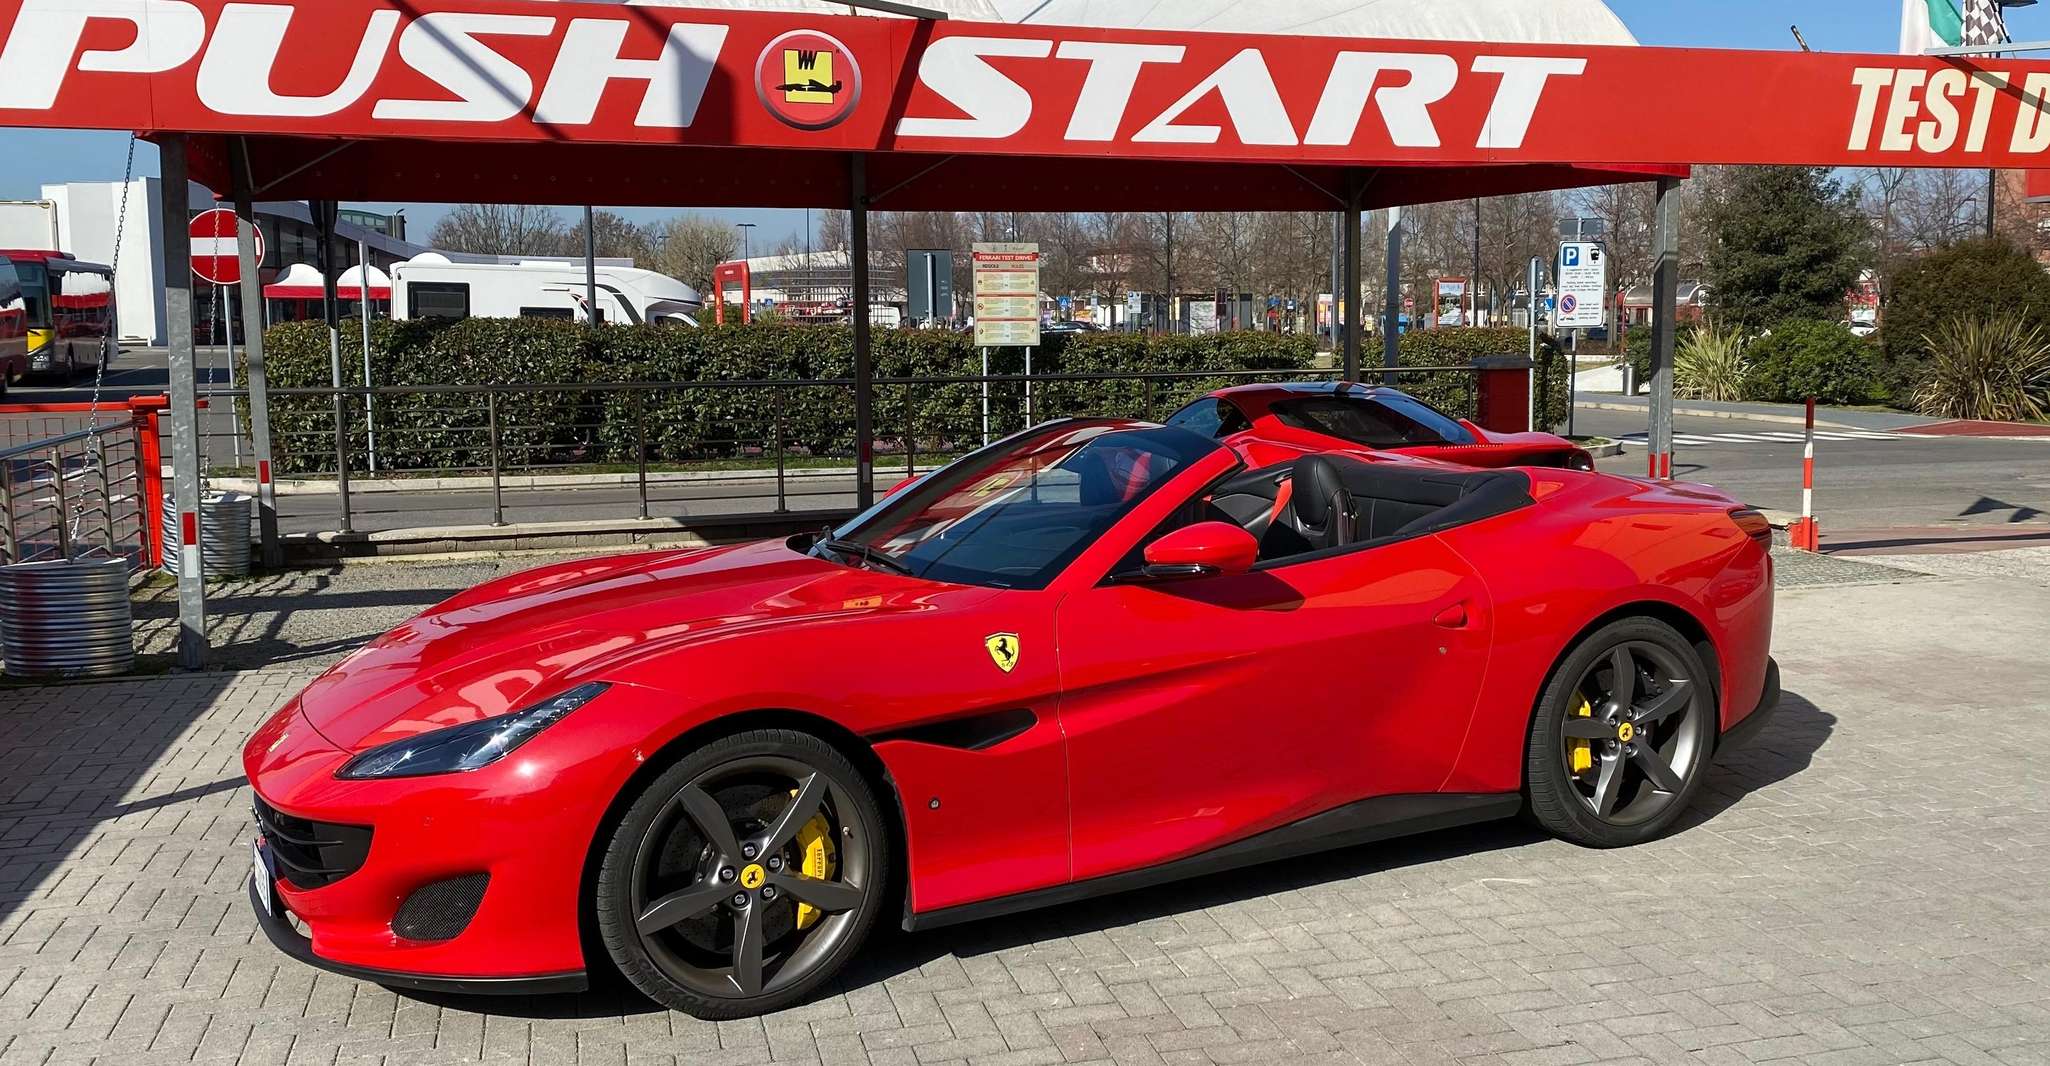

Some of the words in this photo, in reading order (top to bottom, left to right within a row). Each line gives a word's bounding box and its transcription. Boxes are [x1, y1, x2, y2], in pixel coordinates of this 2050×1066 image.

[0, 0, 730, 127] PUSH
[895, 36, 1587, 149] START
[1847, 67, 2011, 154] TEST
[1566, 248, 1577, 265] P
